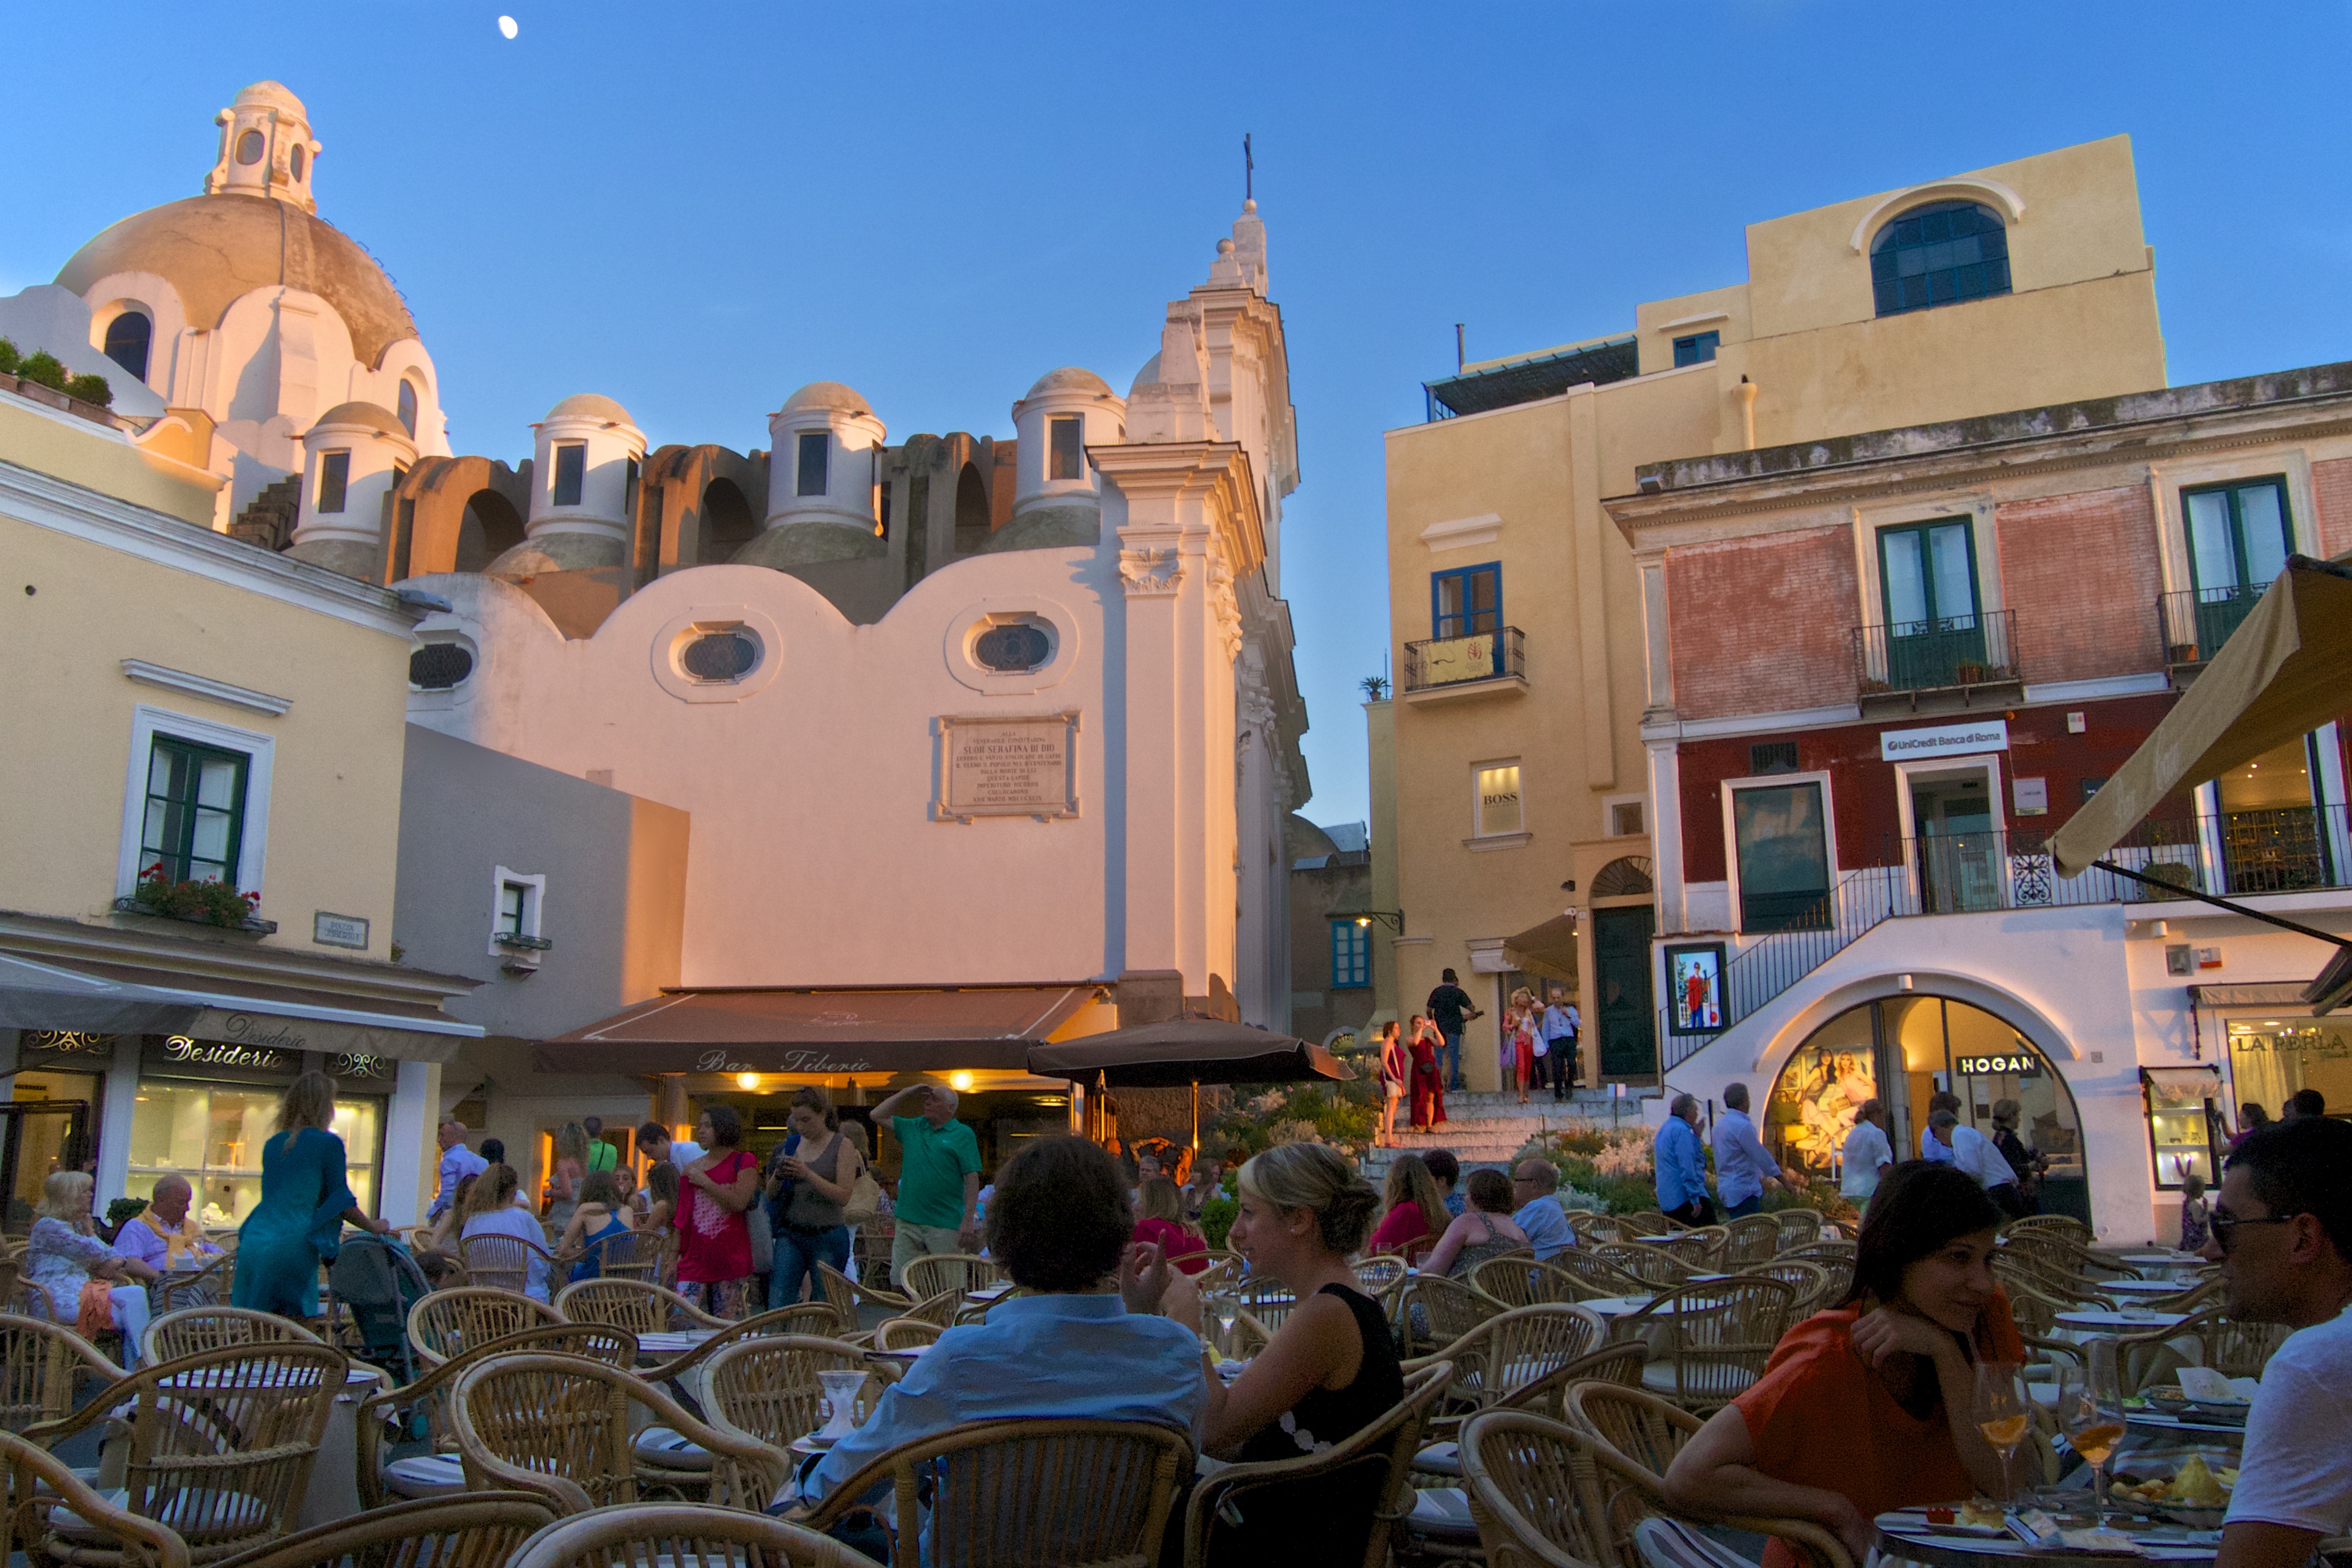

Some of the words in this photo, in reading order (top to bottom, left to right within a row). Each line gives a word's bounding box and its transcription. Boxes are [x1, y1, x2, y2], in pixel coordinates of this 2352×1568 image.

[963, 746, 985, 754] SUOR
[988, 745, 1028, 753] SERAFINA
[1031, 744, 1039, 753] DI
[1041, 744, 1055, 752] DIO
[1898, 738, 1938, 750] UniCredit
[1939, 736, 1965, 745] Banca
[1966, 734, 1974, 743] di
[1975, 733, 2001, 742] Roma
[1483, 791, 1517, 806] BOSS
[330, 921, 355, 931] PIAZZA
[225, 1013, 307, 1048] Desiderio
[164, 1035, 284, 1068] Desiderio
[2237, 1037, 2267, 1052] LA
[2272, 1034, 2347, 1051] PERLA
[696, 1049, 753, 1072] Bar
[780, 1049, 873, 1072] Tiberio
[1962, 1056, 2035, 1073] HOGAN
